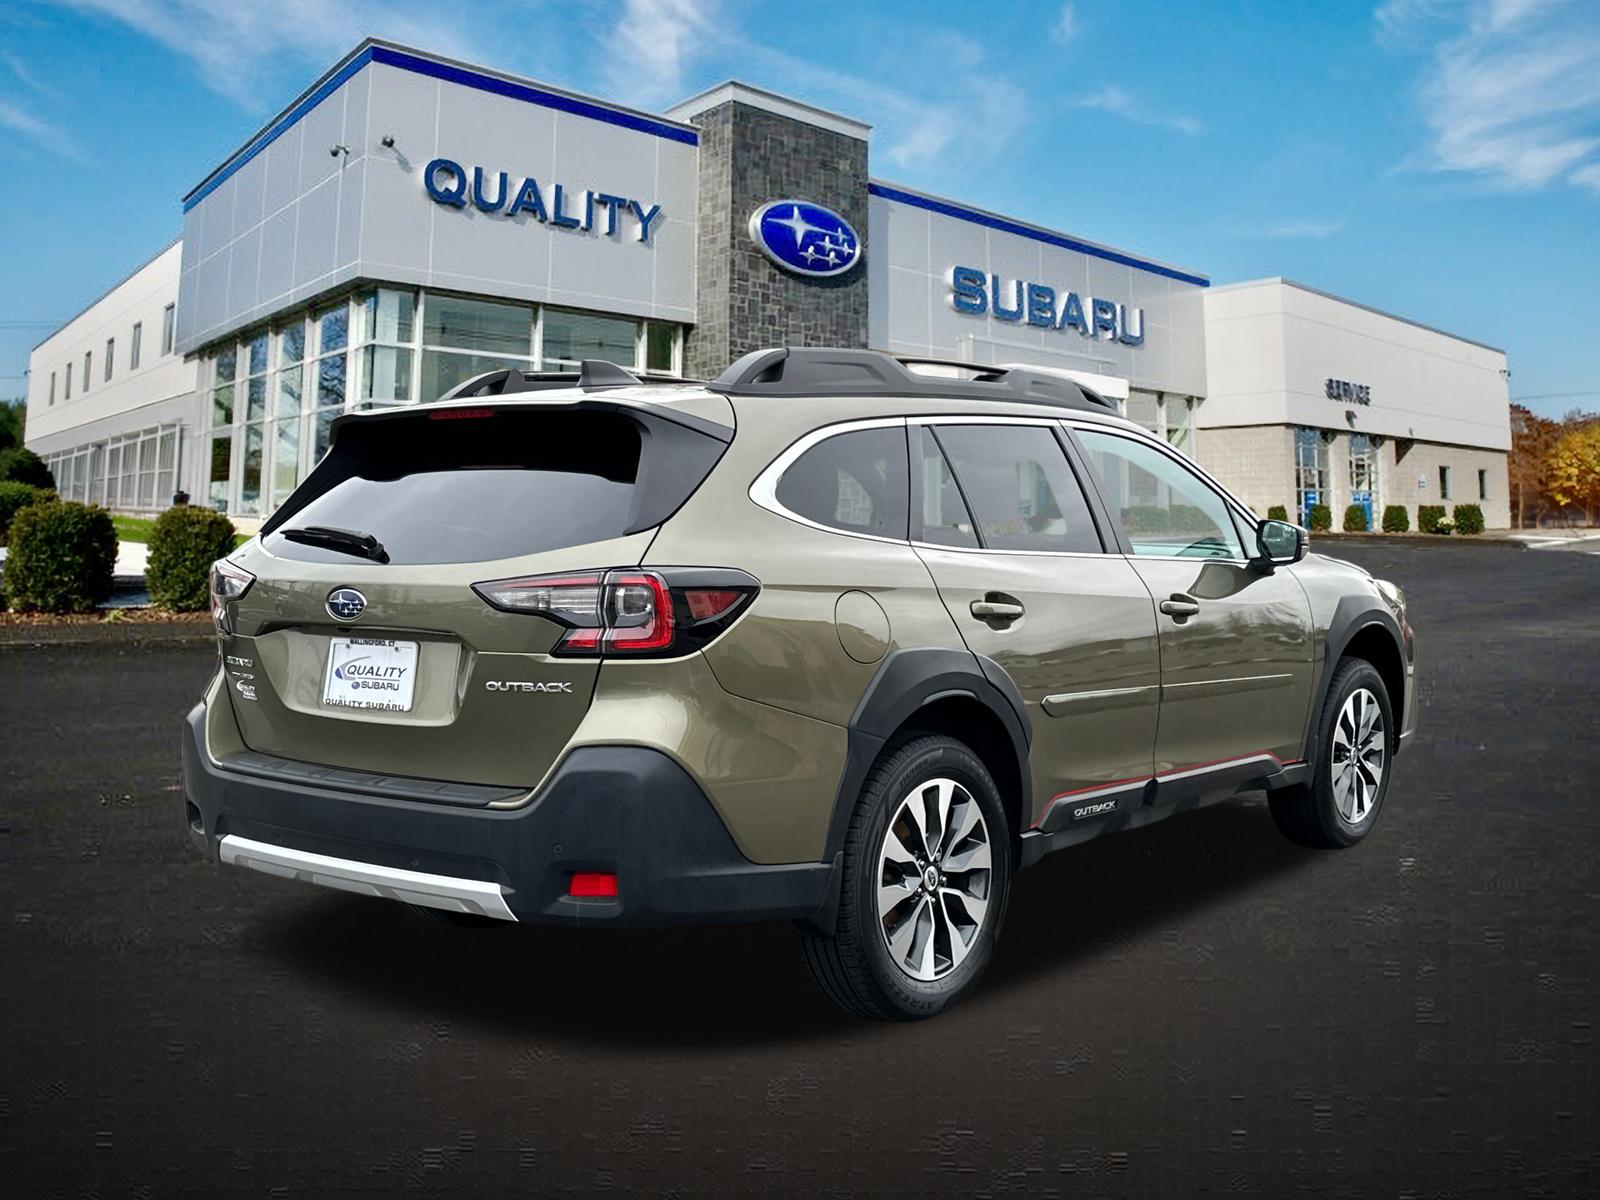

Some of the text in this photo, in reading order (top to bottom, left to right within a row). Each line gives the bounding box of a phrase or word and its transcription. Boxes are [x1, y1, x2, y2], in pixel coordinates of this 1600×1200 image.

[424, 158, 661, 243] QUALITY
[951, 265, 1145, 346] SUBARU
[347, 664, 407, 678] QUALITY
[361, 681, 399, 691] SUBARU
[485, 681, 573, 693] OUTBACK
[325, 698, 404, 711] QUALITY SUBARU
[1074, 800, 1116, 817] OUTBACK
